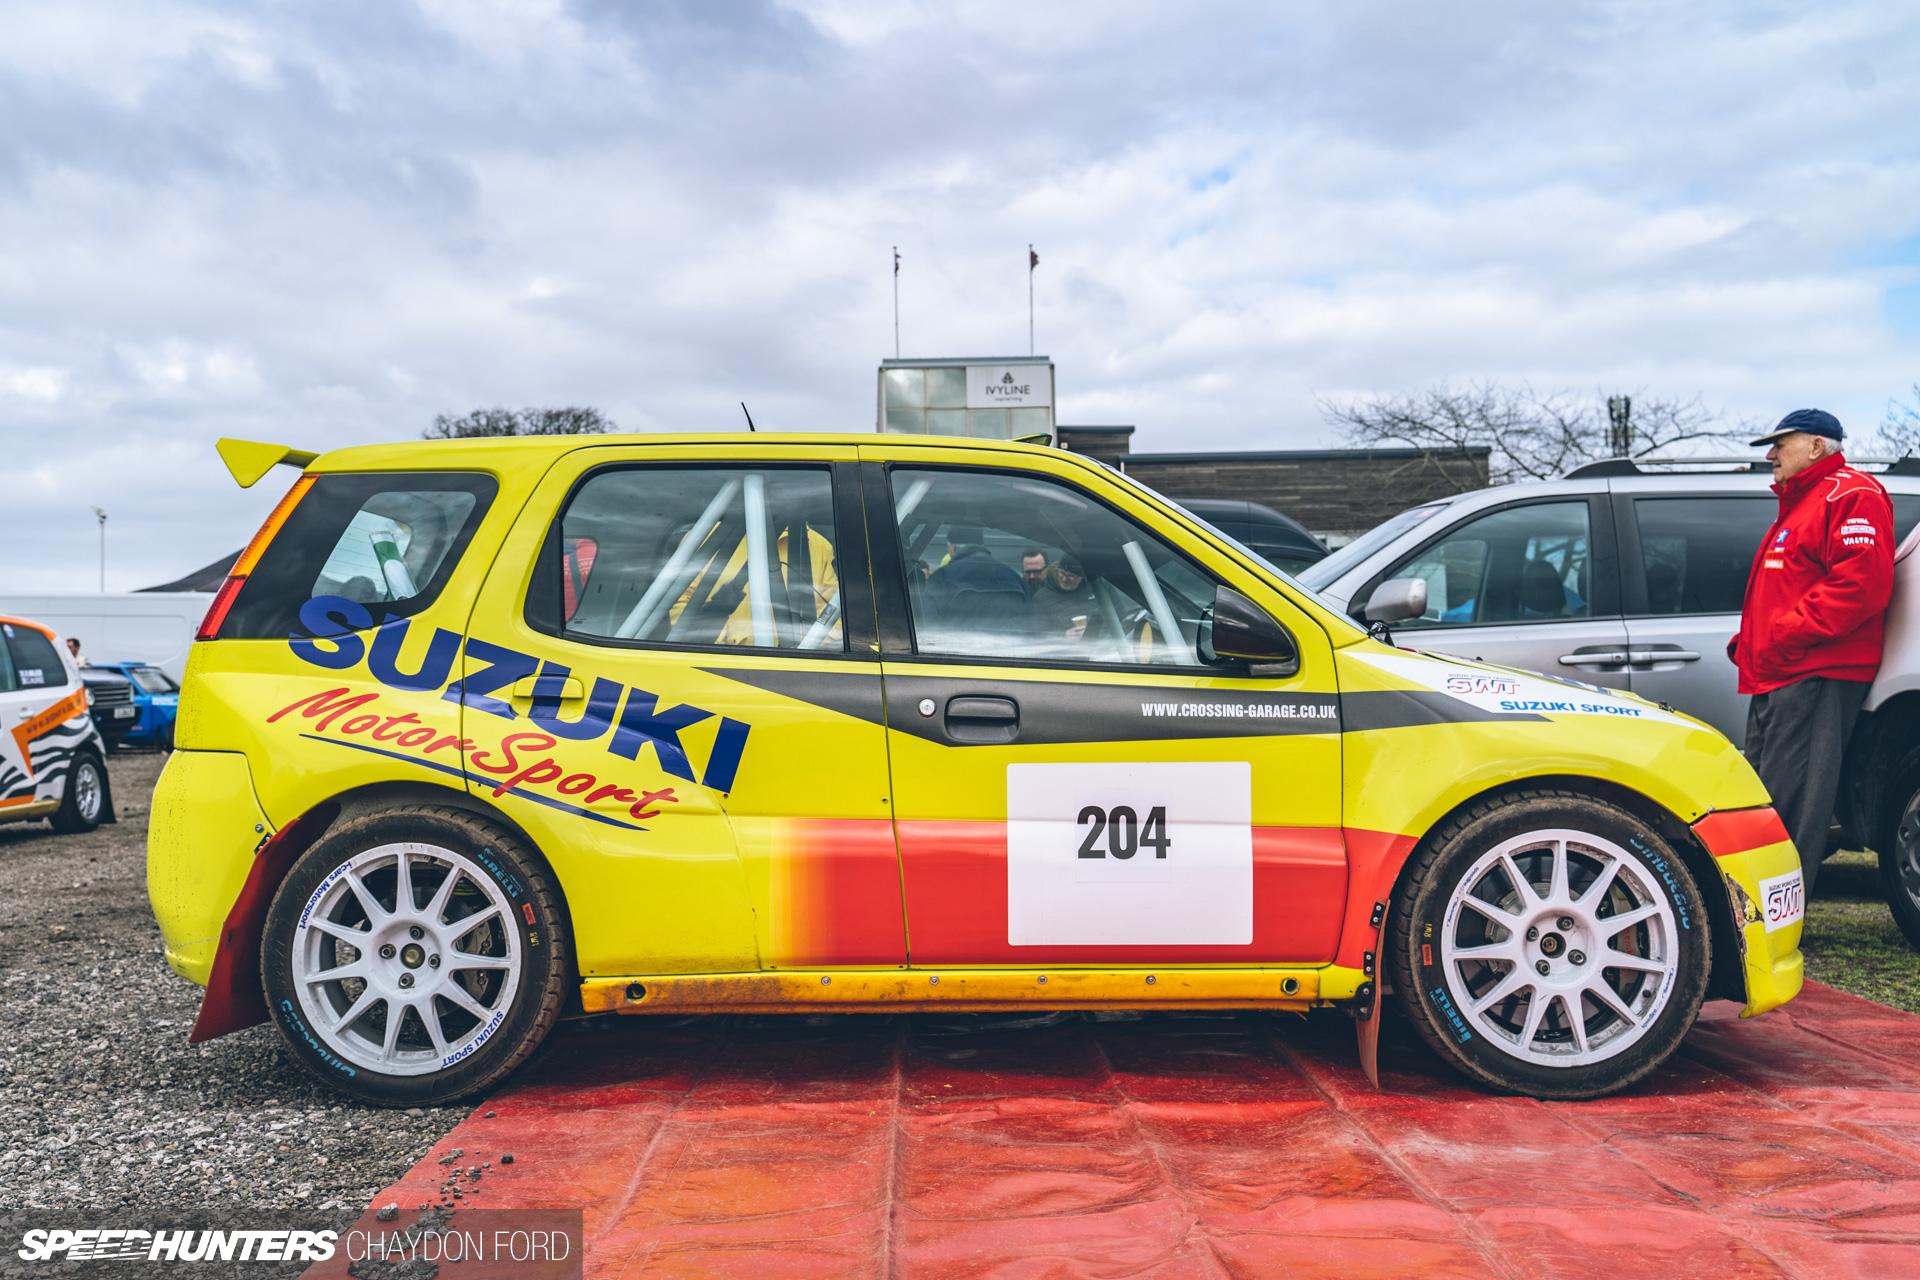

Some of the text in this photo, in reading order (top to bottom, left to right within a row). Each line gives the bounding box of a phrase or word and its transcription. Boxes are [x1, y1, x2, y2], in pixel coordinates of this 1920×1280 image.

[985, 384, 1031, 395] IVYLINE
[1843, 537, 1875, 546] VALTRA
[288, 594, 752, 794] SUZUKI
[1447, 677, 1520, 695] SWT
[1141, 703, 1337, 719] WWW.CROSSING-GARAGE.CO.UK
[1500, 701, 1641, 717] SUZUKI SPORT
[1077, 805, 1171, 860] 204
[477, 848, 524, 898] PIRELLI
[299, 861, 352, 930] i-cars Motorsport
[1768, 883, 1802, 922] SWT
[1429, 987, 1473, 1044] PIRELLI
[442, 1011, 504, 1067] SUZUKI SPORT
